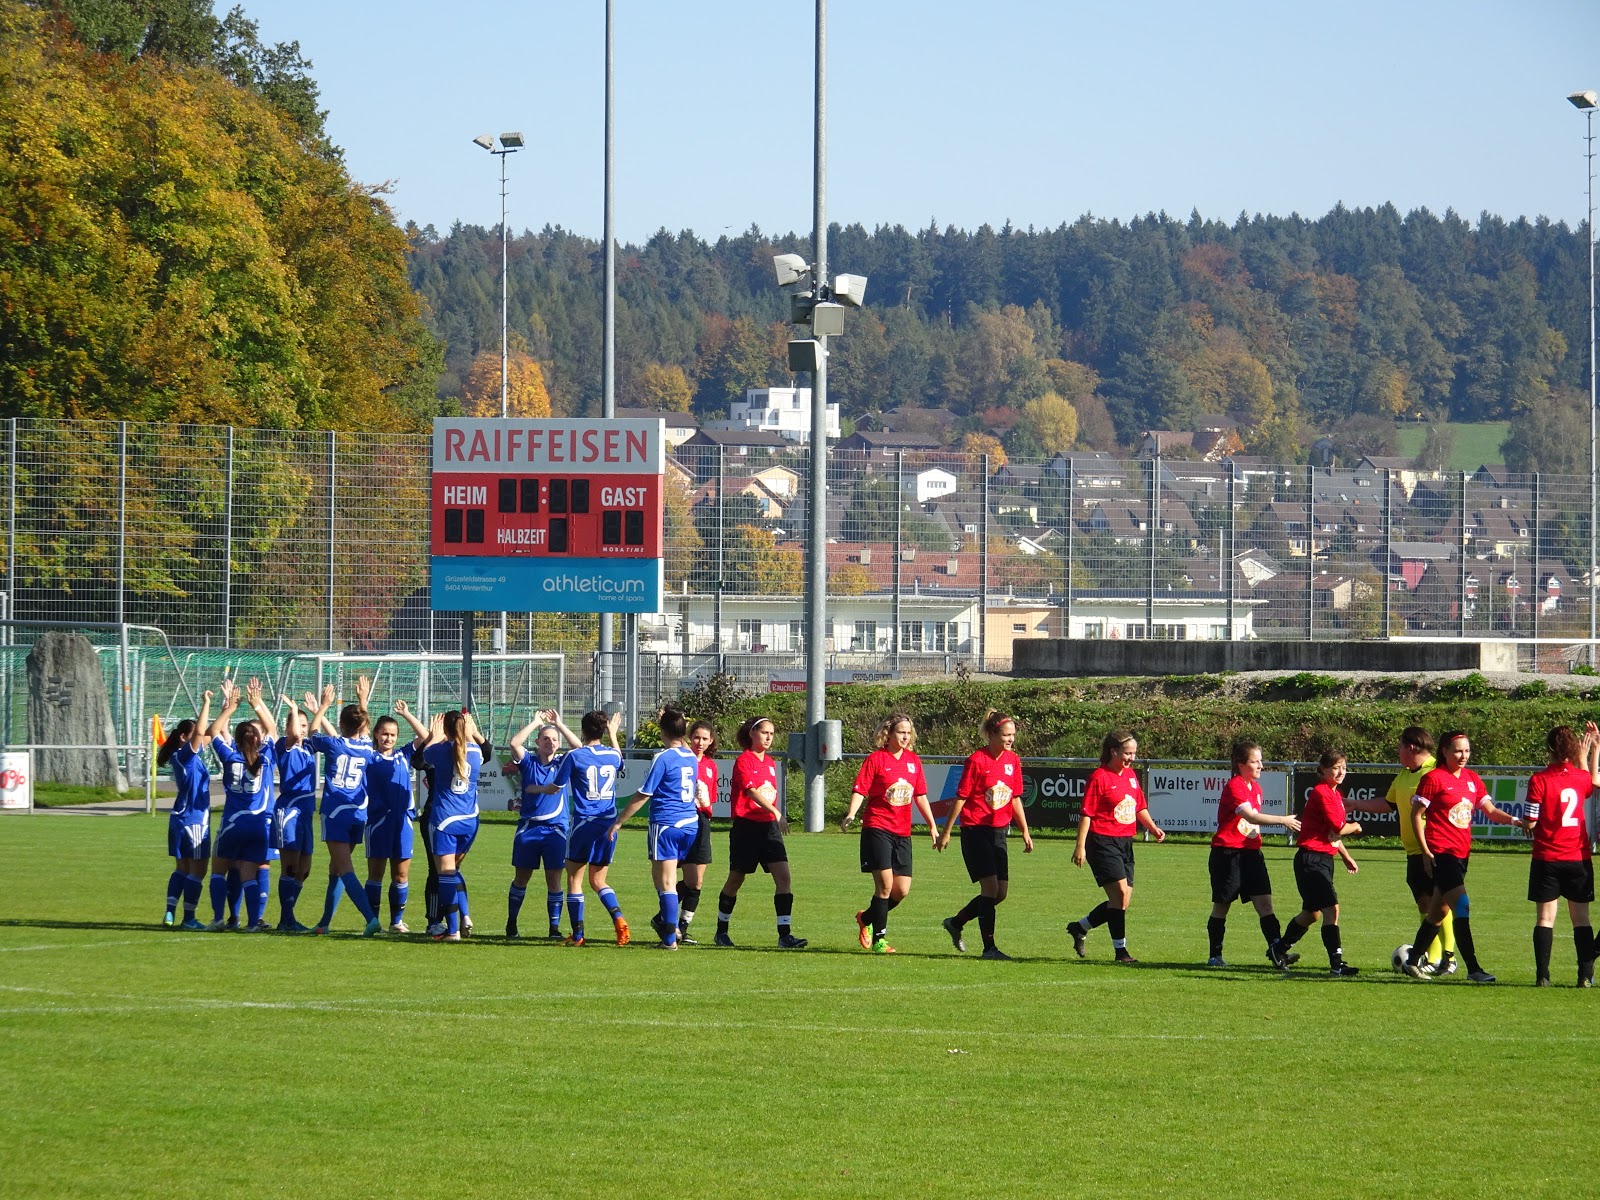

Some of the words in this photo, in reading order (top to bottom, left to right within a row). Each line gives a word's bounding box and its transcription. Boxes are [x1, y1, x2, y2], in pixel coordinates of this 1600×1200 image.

[445, 429, 647, 462] RAIFFEISEN
[444, 486, 487, 505] HEIM
[601, 487, 647, 506] GAST
[497, 528, 546, 544] HALBZEIT
[543, 574, 645, 593] athleticum
[625, 595, 645, 603] sports
[772, 683, 804, 692] Rauchfrei!
[331, 754, 366, 789] 15
[489, 770, 498, 778] AG
[586, 765, 617, 801] 12
[681, 766, 695, 803] 5
[1154, 776, 1200, 791] Walter
[1203, 777, 1229, 791] Wit
[1041, 800, 1070, 809] Garten-
[1560, 787, 1579, 828] 2
